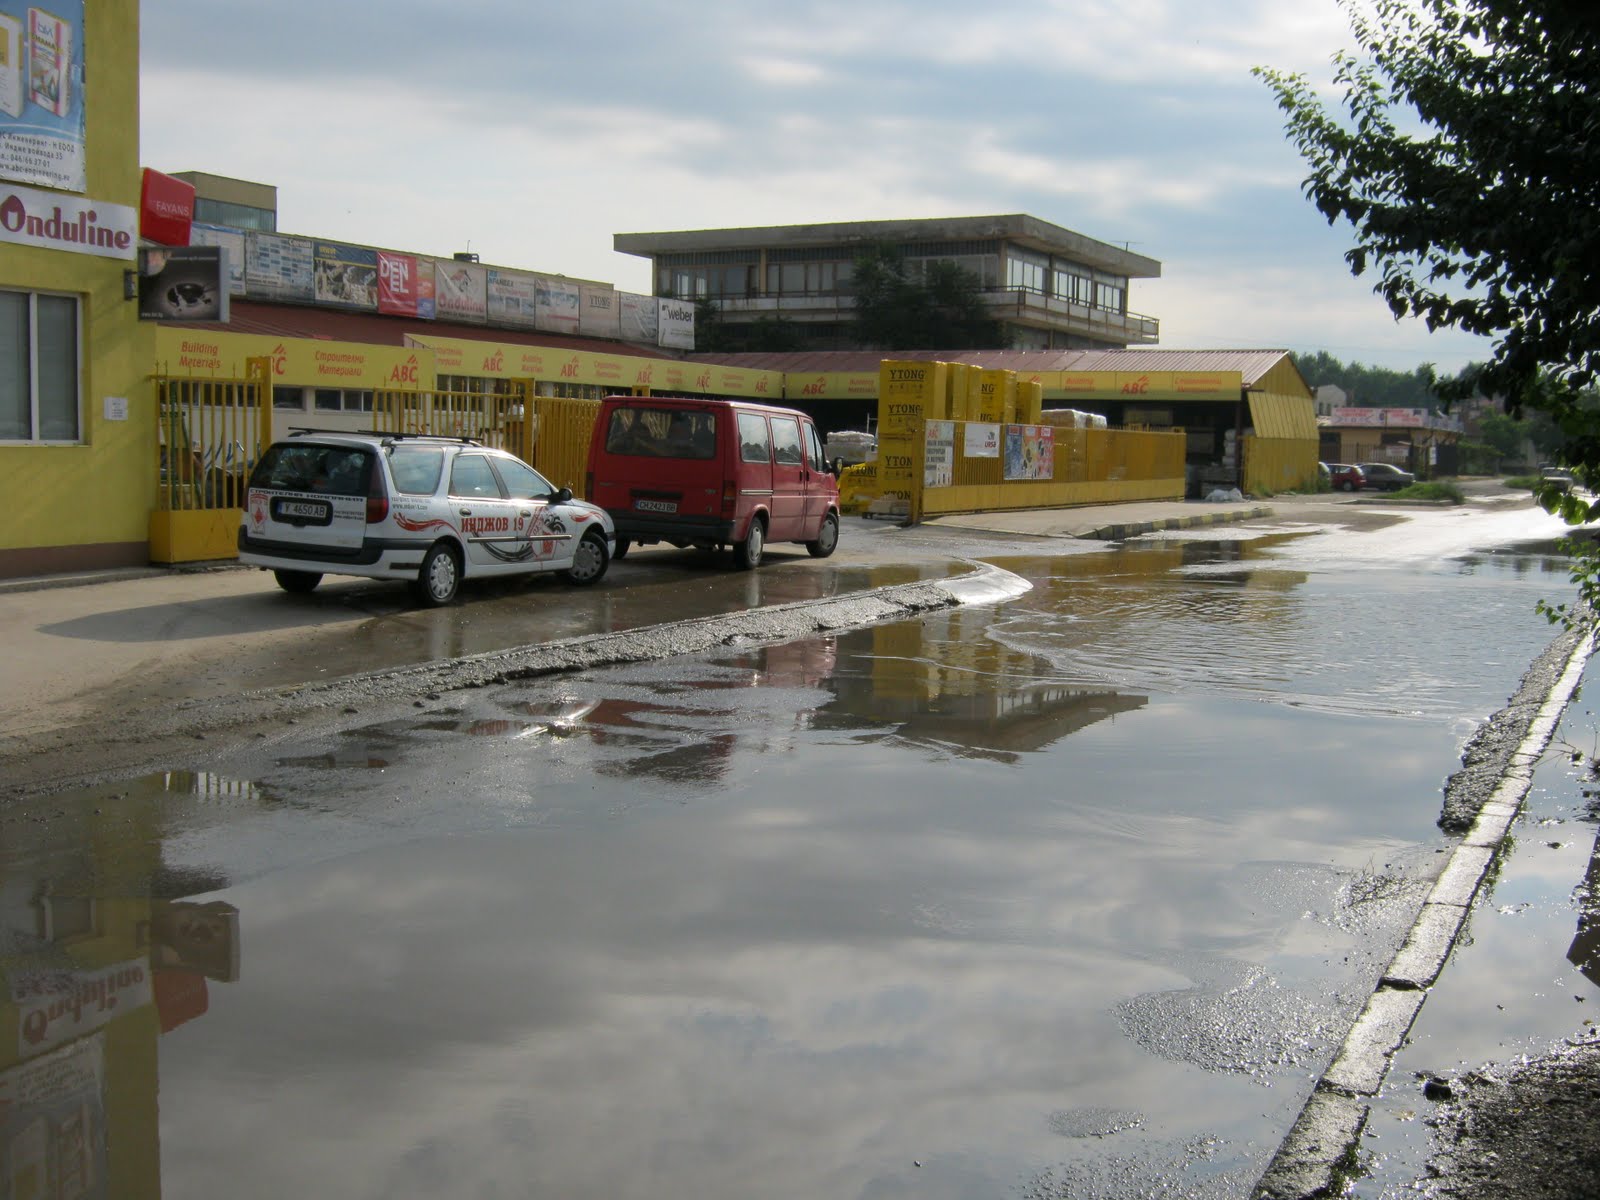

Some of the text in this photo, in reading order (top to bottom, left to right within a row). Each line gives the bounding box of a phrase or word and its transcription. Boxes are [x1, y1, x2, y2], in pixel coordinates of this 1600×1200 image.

[156, 201, 190, 217] FAYANS
[0, 194, 131, 250] Onduline
[666, 304, 693, 322] weber
[181, 341, 219, 356] Building
[179, 355, 222, 369] Materials
[482, 357, 503, 372] ABC
[390, 364, 418, 382] ABC
[560, 363, 578, 377] ABC
[890, 369, 924, 380] YTONG
[801, 383, 826, 394] ABC
[1120, 383, 1148, 394] ABC
[885, 456, 912, 466] YTON
[293, 504, 313, 515] 4650
[314, 506, 325, 516] AB
[461, 517, 524, 533] ИНДЖОВ 19
